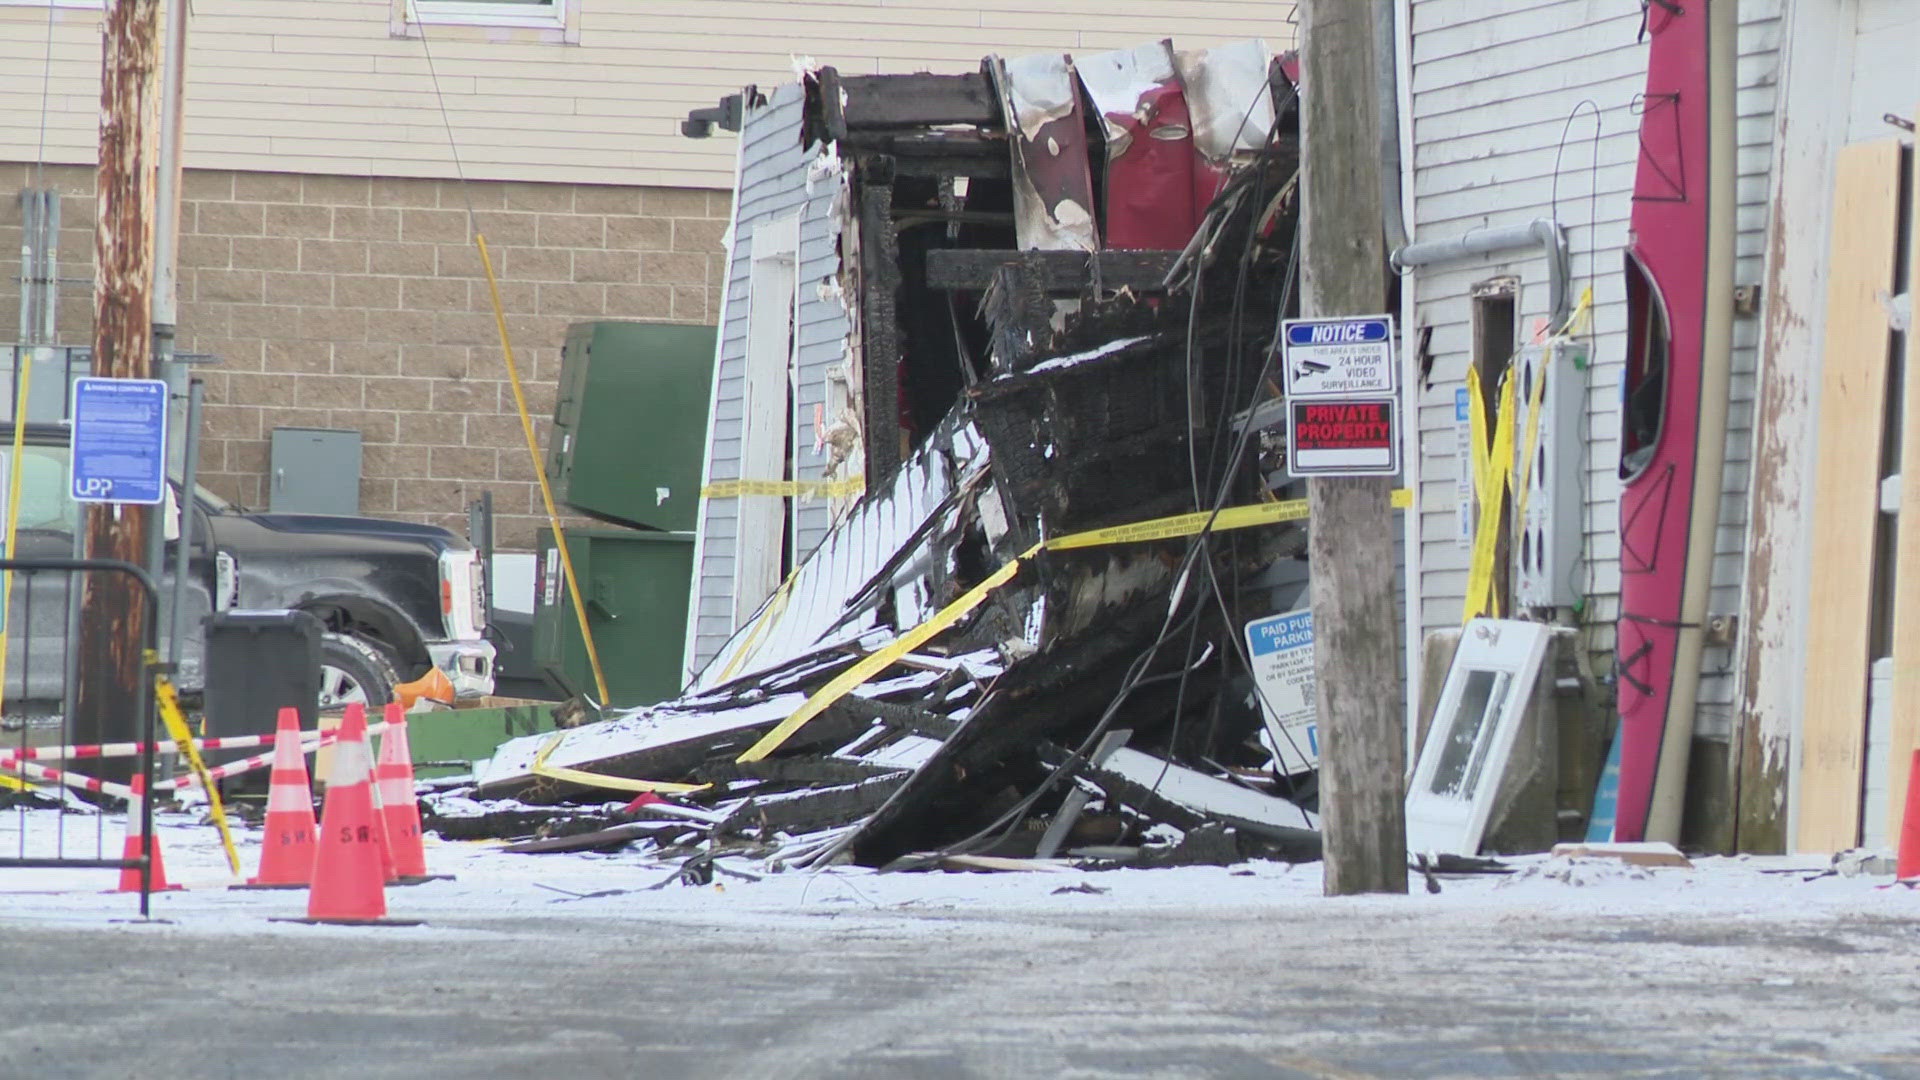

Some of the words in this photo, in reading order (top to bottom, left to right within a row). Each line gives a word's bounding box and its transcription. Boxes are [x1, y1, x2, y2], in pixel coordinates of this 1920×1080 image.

[1311, 324, 1367, 342] NOTICE
[1339, 357, 1352, 367] 24
[1354, 355, 1382, 365] HOUR
[1346, 367, 1376, 378] VIDEO
[1321, 379, 1383, 389] SURVEILLANCE
[1306, 405, 1379, 422] PRIVATE
[1297, 423, 1389, 439] PROPERTY
[1260, 622, 1287, 638] PAID
